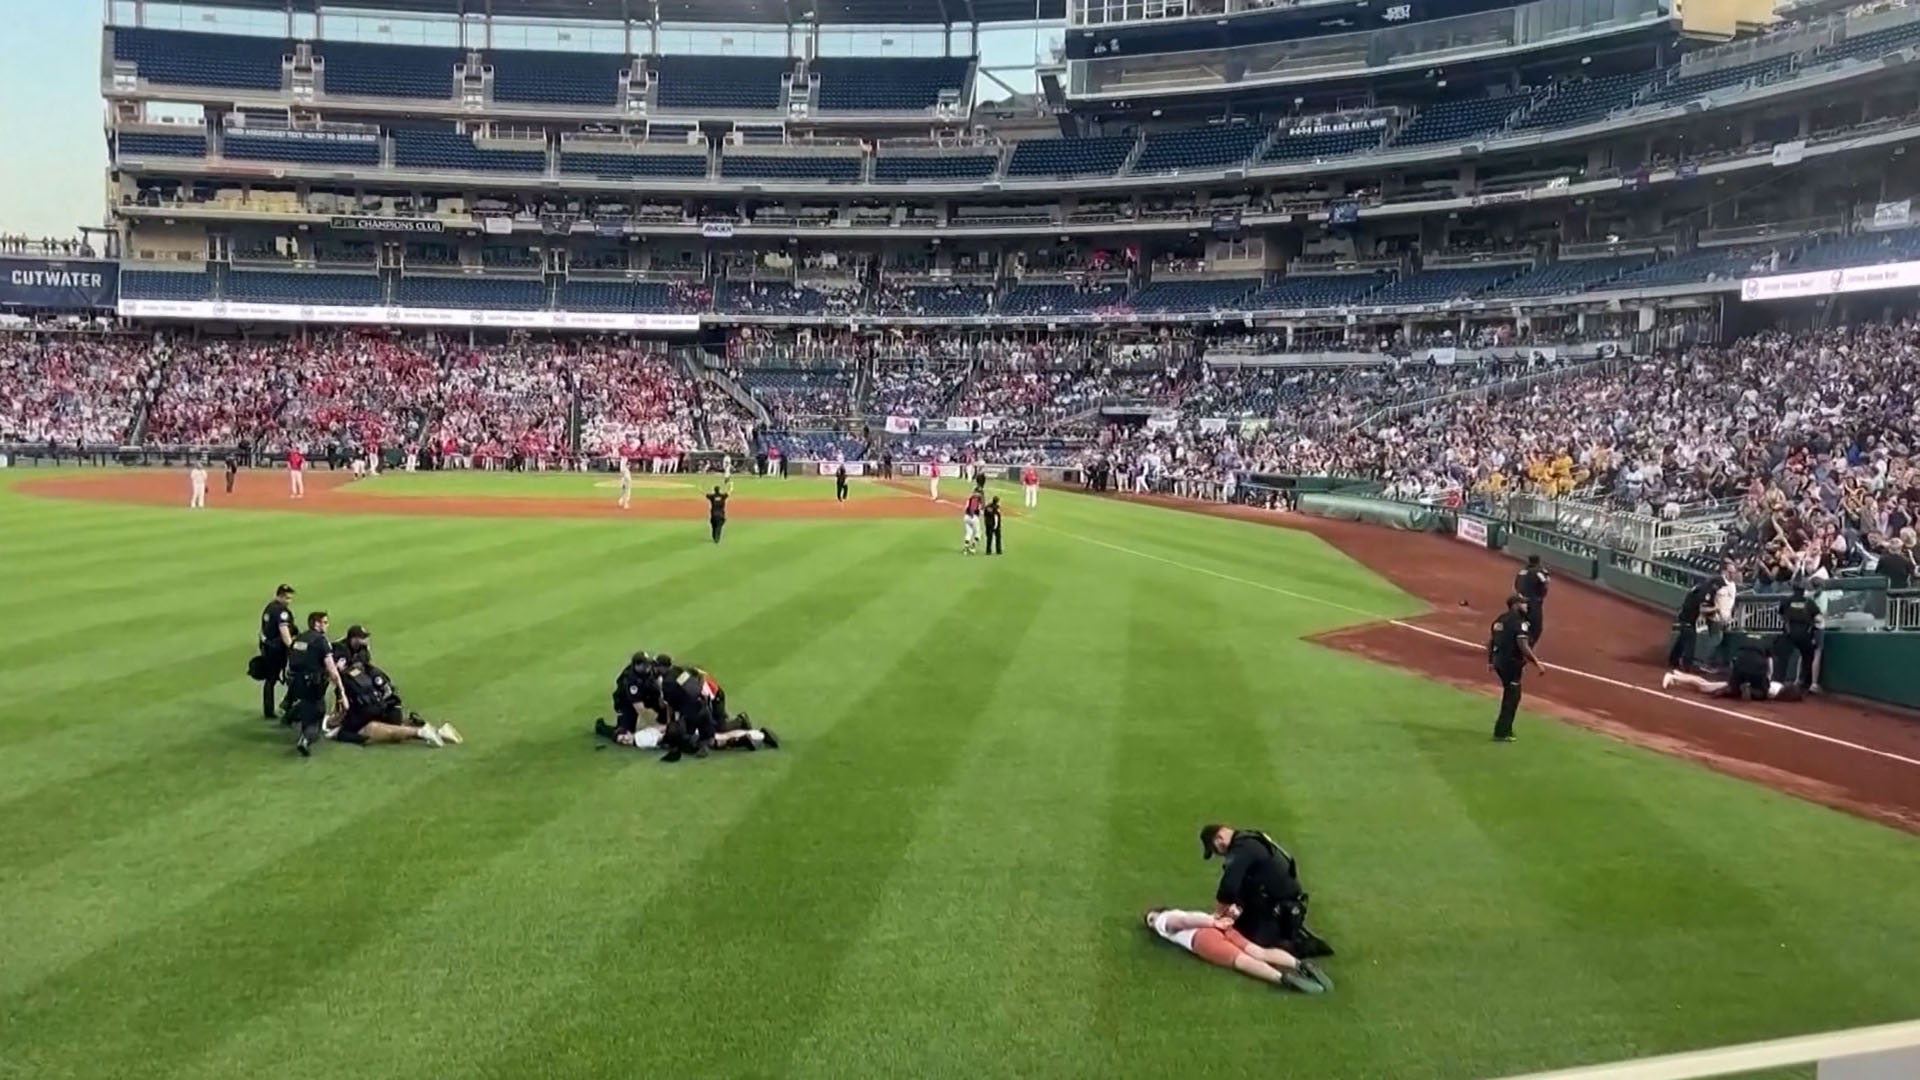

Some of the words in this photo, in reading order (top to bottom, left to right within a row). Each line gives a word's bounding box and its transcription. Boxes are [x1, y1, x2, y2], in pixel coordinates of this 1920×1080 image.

[358, 219, 414, 231] CHAMPIONS
[416, 222, 441, 232] CLUB
[11, 269, 102, 288] CUTWATER
